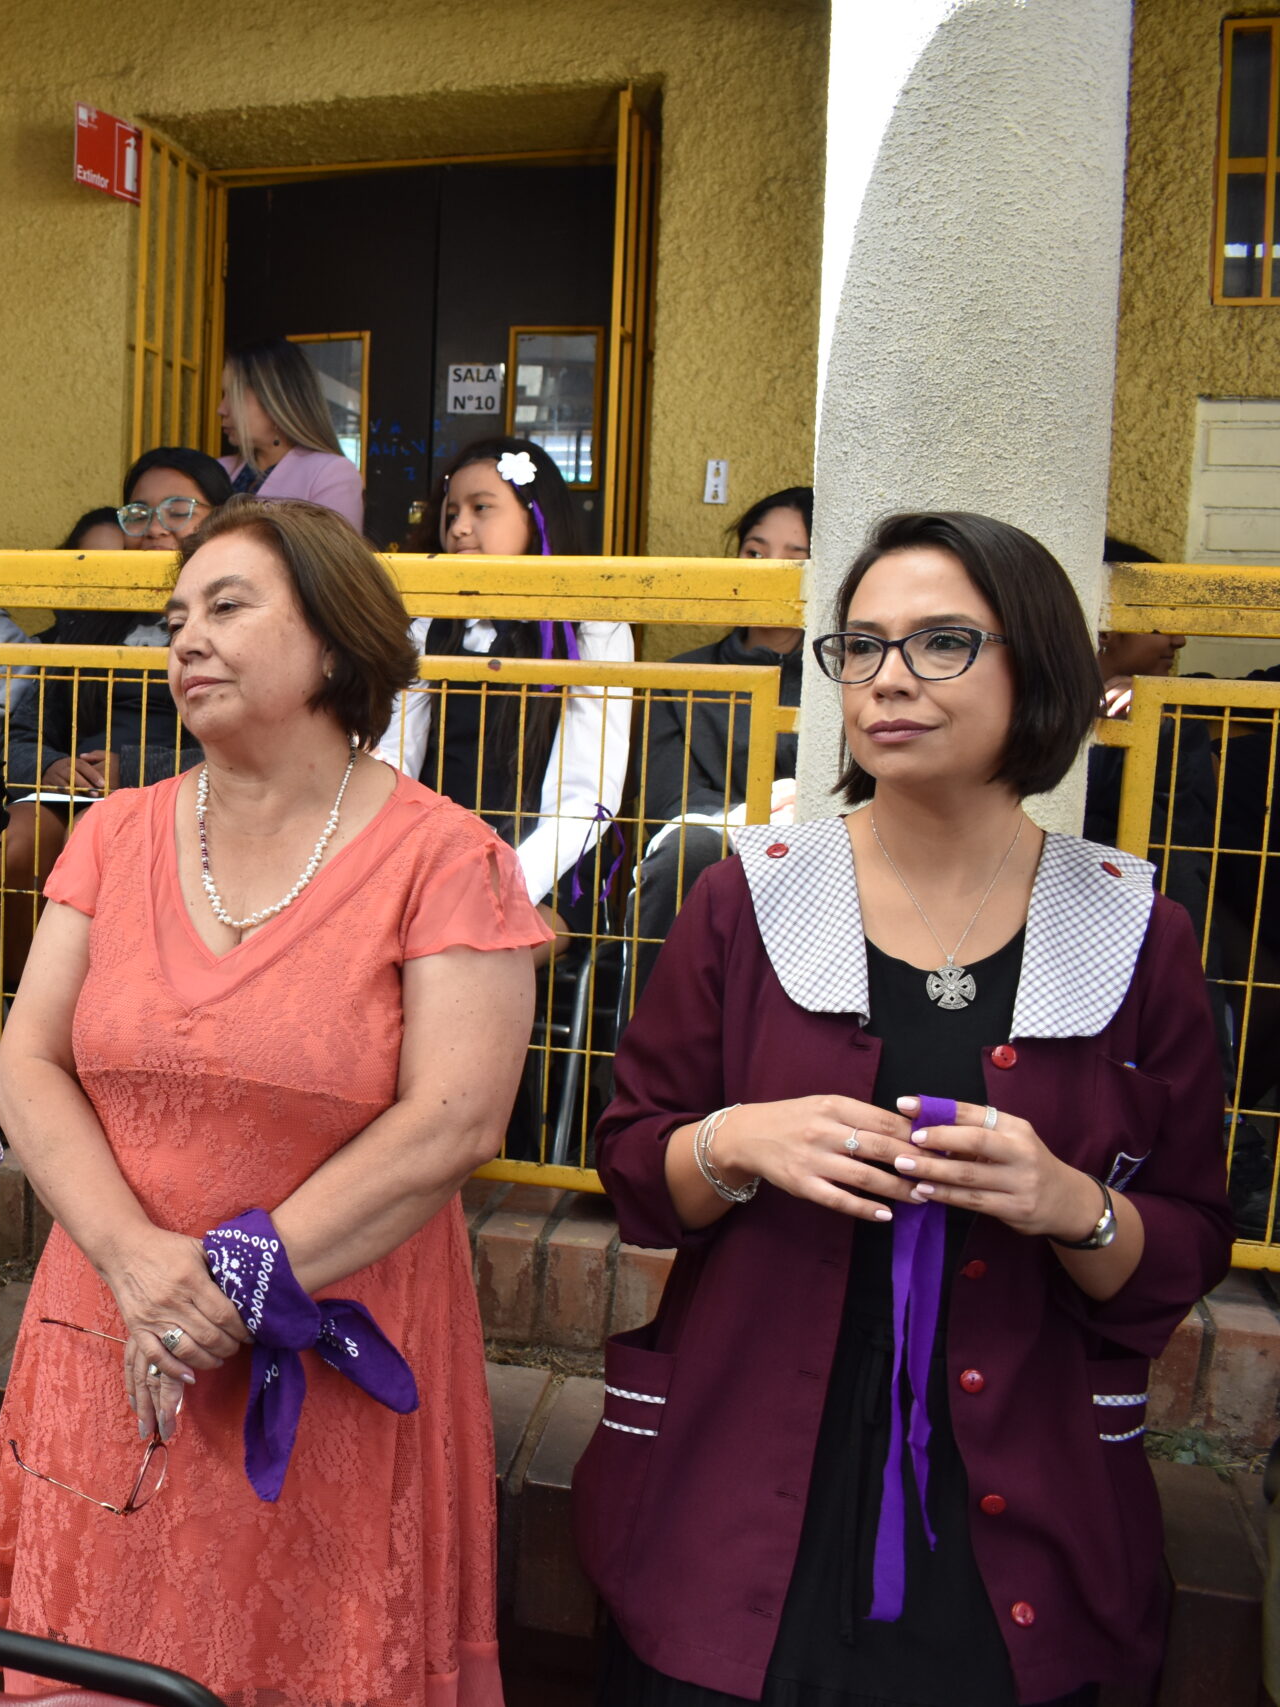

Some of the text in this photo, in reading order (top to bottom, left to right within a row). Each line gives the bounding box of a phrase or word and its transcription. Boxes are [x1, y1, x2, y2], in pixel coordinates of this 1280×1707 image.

[77, 164, 109, 189] Extintor
[452, 367, 497, 383] SALA
[453, 394, 496, 410] N°10
